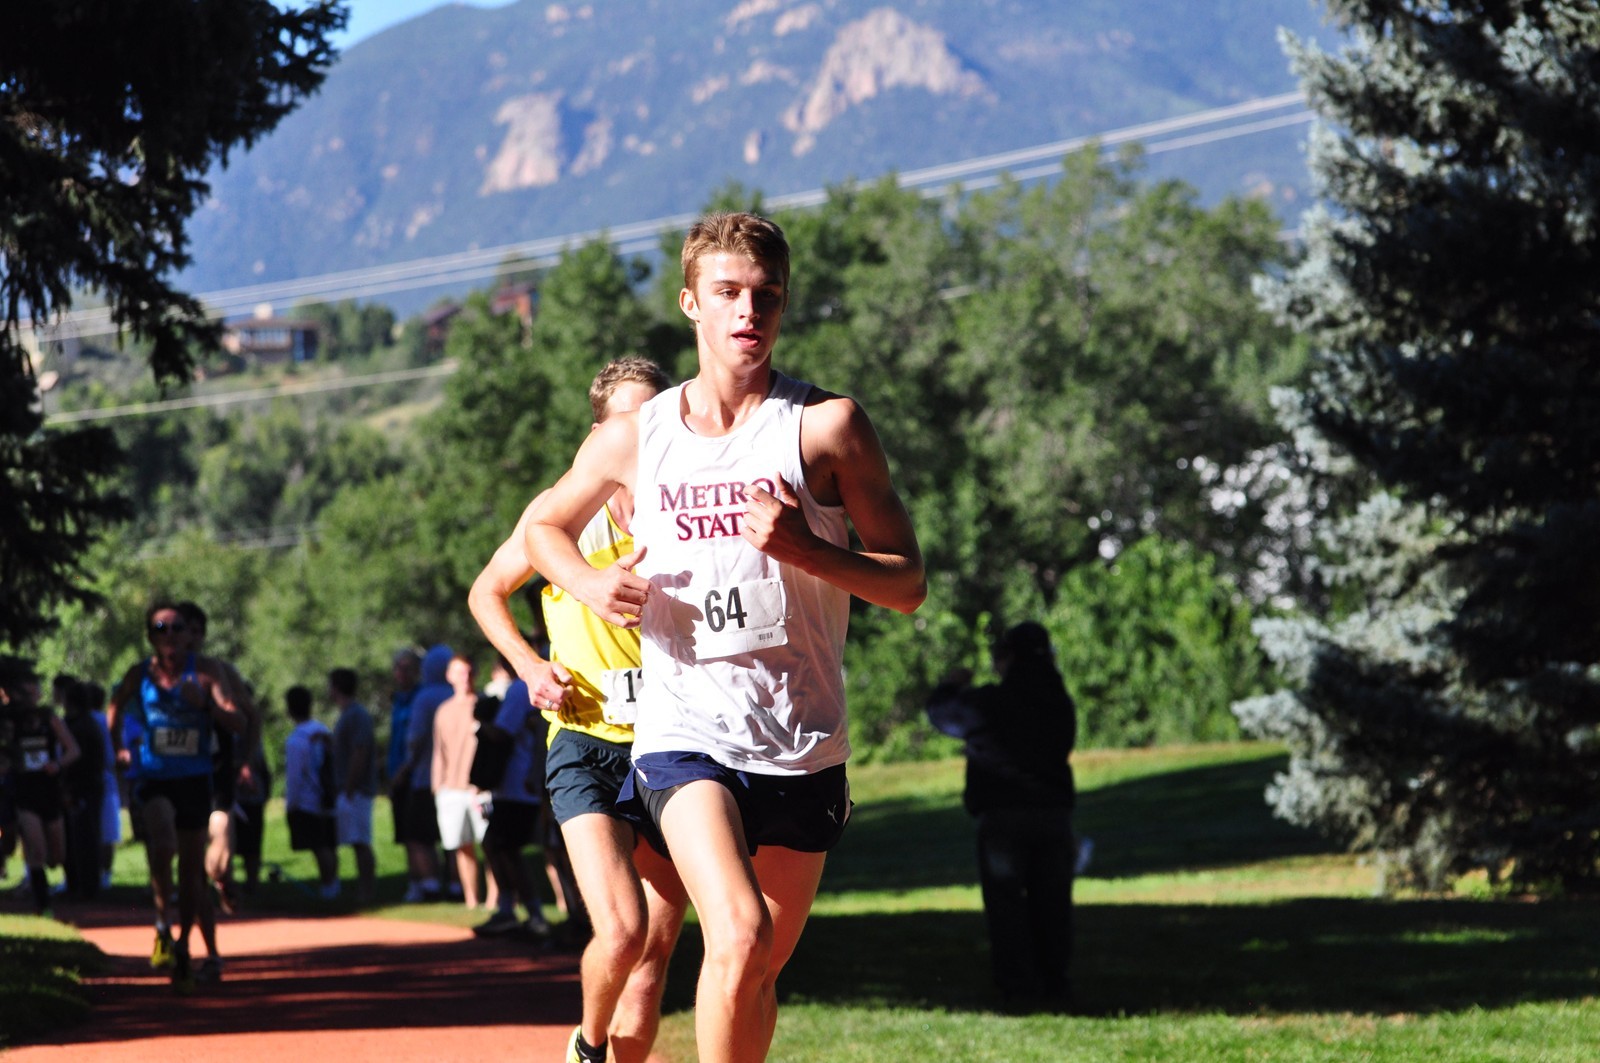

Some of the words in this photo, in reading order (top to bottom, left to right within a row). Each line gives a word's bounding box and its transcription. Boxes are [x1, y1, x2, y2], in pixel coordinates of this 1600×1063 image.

[675, 511, 750, 541] STAT
[704, 586, 748, 632] 64
[623, 668, 643, 703] 1
